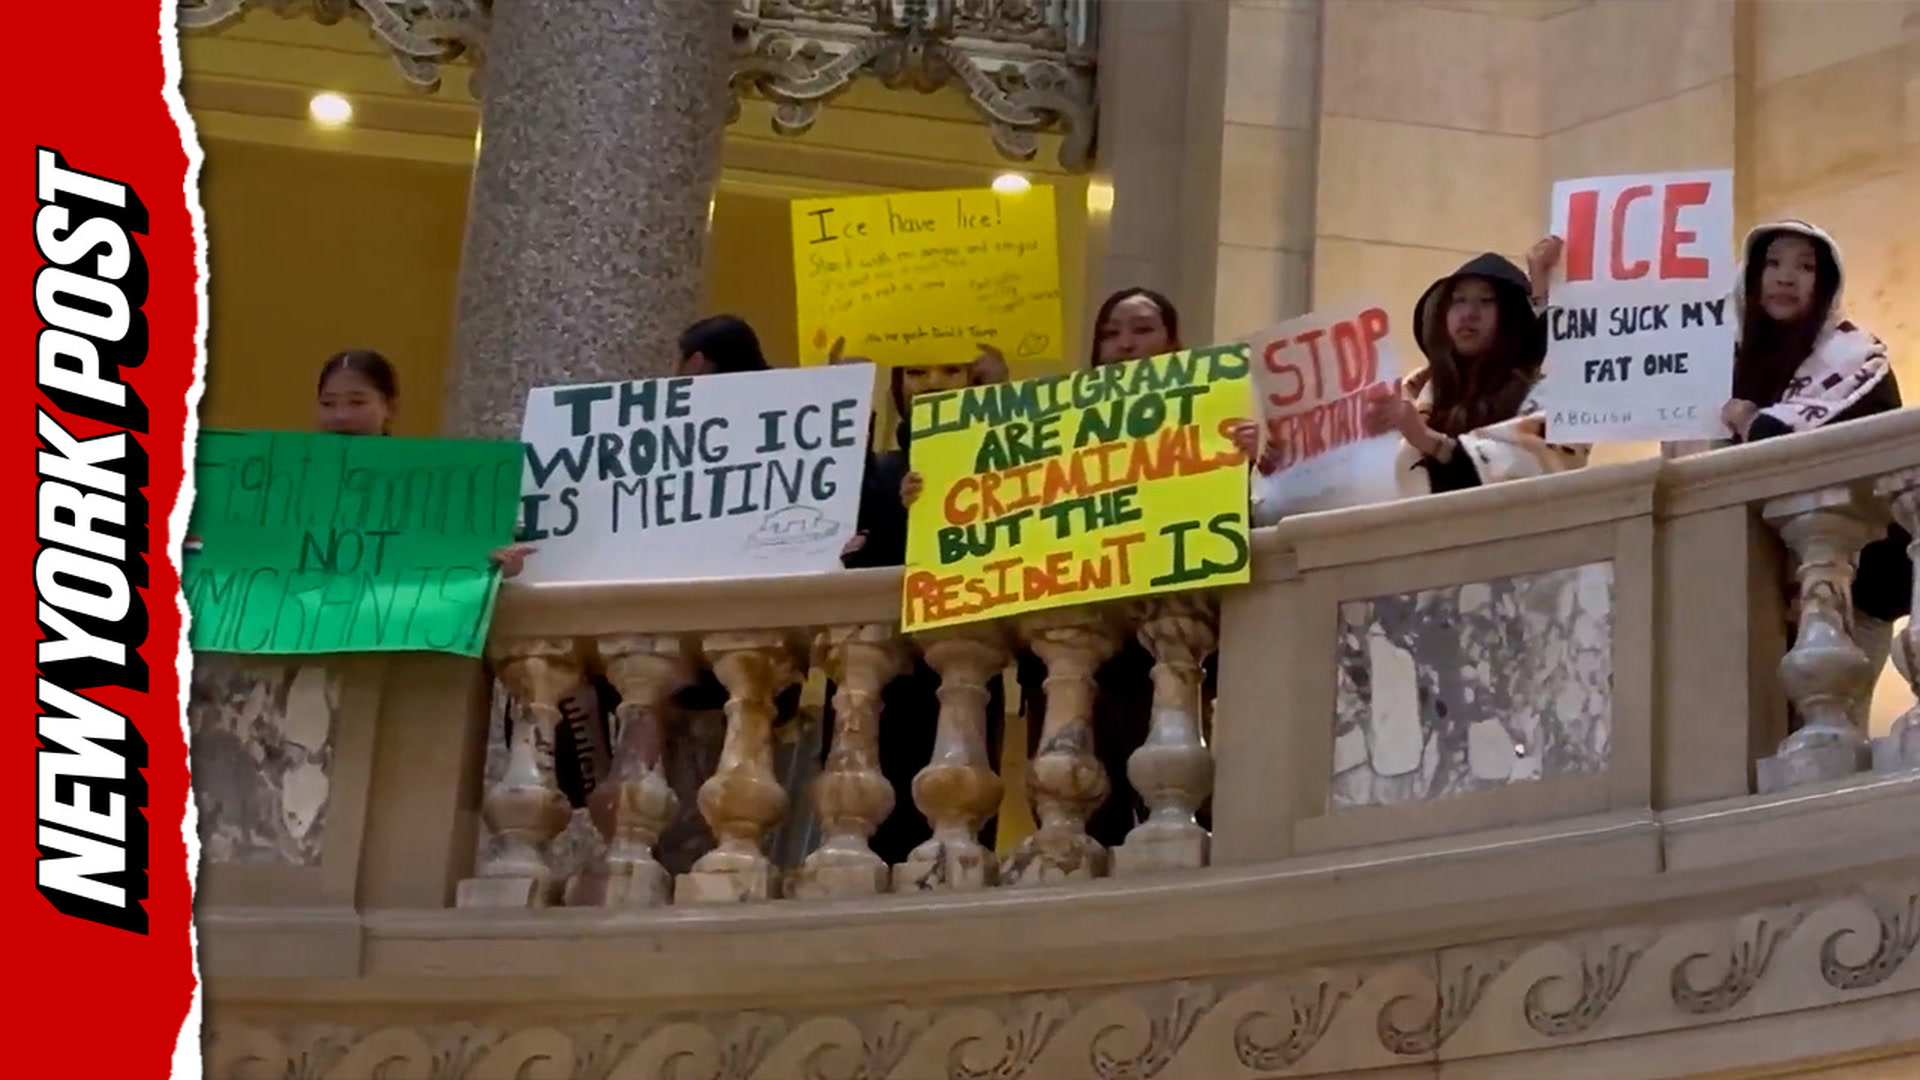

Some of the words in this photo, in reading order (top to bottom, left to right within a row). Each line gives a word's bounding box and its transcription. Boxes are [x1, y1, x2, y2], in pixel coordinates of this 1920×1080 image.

[807, 207, 868, 244] Ice
[886, 199, 936, 235] have
[956, 197, 1002, 230] lice!
[1565, 182, 1711, 282] ICE
[1263, 307, 1389, 406] STOP
[1551, 308, 1598, 341] CAN
[1608, 304, 1670, 337] SUCK
[1681, 299, 1726, 329] MY
[554, 378, 694, 436] THE
[911, 343, 1251, 441] IMMIGRANTS
[1584, 356, 1632, 384] FAT
[1643, 352, 1688, 377] ONE
[524, 417, 729, 489] WRONG
[755, 398, 858, 454] ICE
[973, 414, 1063, 474] ARE
[1073, 385, 1211, 450] NOT
[1553, 411, 1632, 426] ABOLISH
[1656, 405, 1699, 421] ICE
[519, 487, 580, 542] IS
[611, 455, 838, 533] MELTING
[943, 417, 1251, 526] CRIMINALS
[298, 528, 402, 577] NOT
[938, 509, 1034, 565] BUT
[1040, 486, 1143, 540] THE
[1150, 513, 1250, 586] IS
